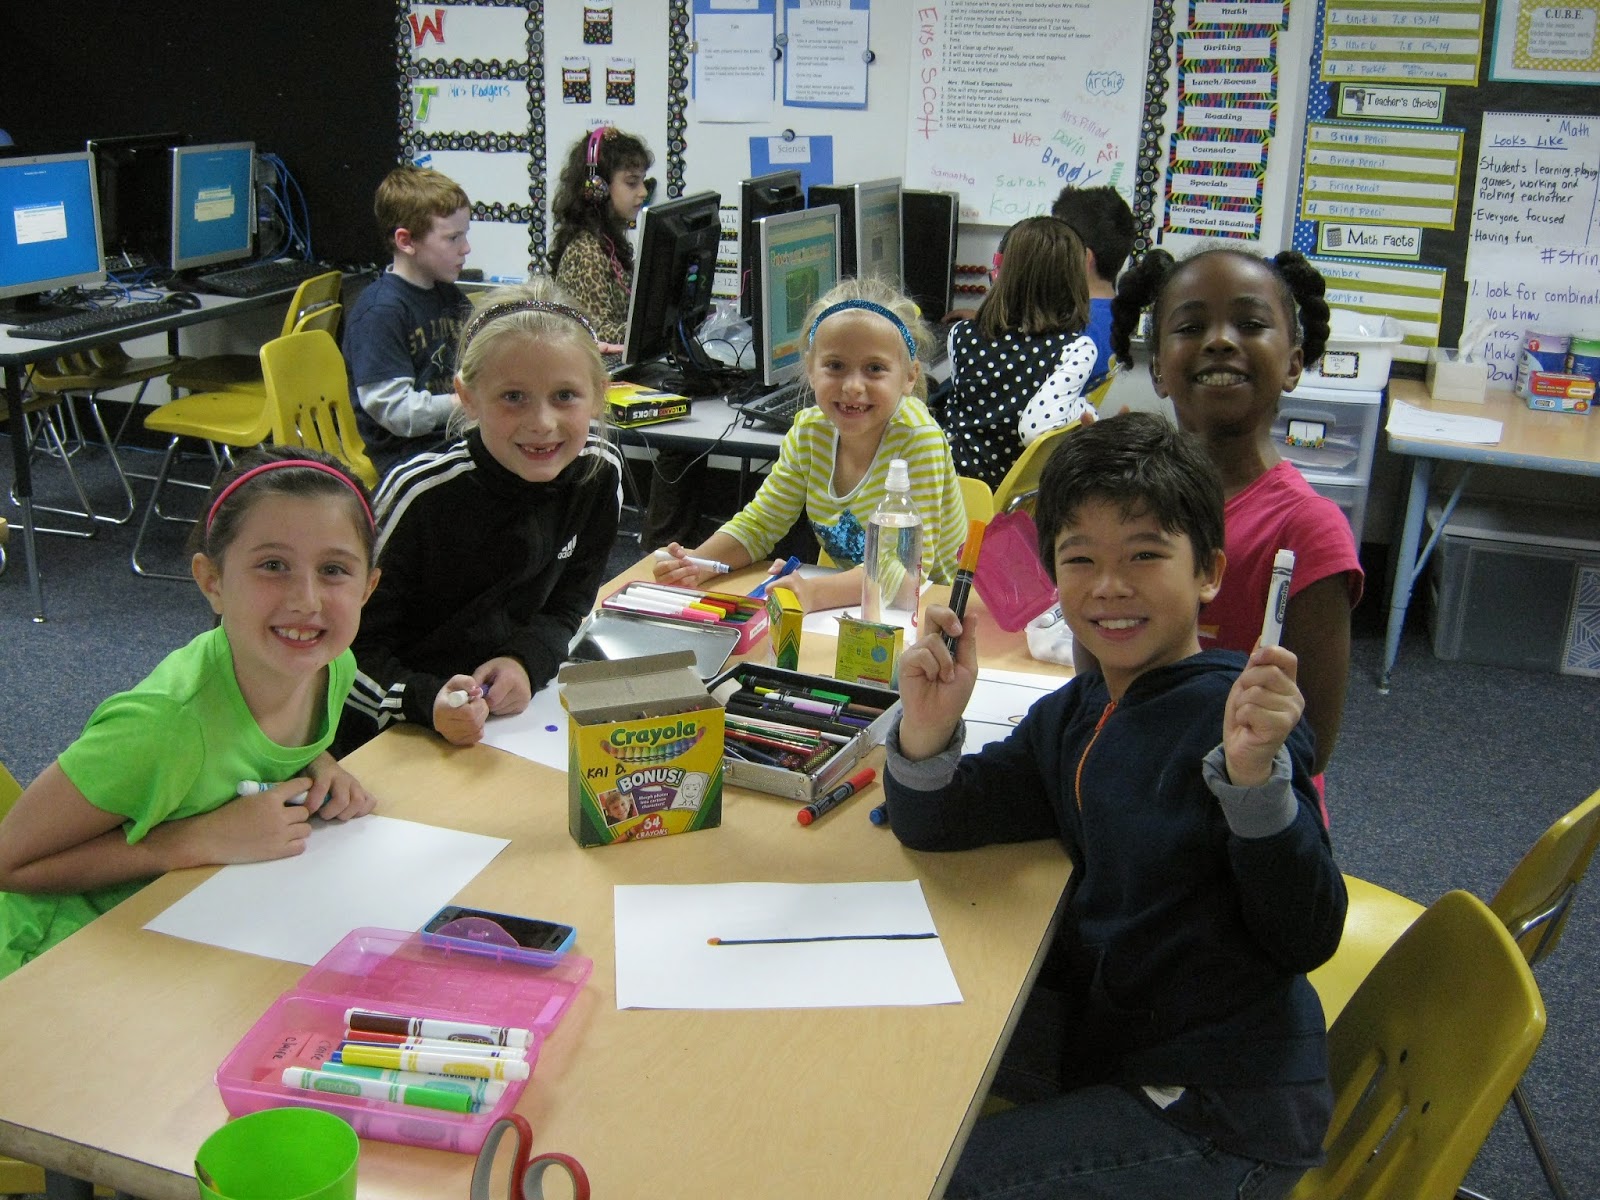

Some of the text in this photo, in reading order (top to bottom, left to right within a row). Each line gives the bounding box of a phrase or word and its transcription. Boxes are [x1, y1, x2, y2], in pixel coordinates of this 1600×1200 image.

[407, 8, 447, 48] W
[1203, 43, 1242, 52] Writing
[1366, 92, 1438, 109] Teacher's Choice
[1204, 112, 1243, 121] Reading
[1559, 120, 1590, 137] Math
[1494, 134, 1564, 146] Looks Like
[777, 144, 806, 153] Science
[1192, 145, 1237, 154] Counselor
[1480, 156, 1527, 173] Students
[996, 174, 1047, 188] Sarah
[1189, 179, 1229, 188] Specials
[1520, 178, 1556, 193] working
[1561, 178, 1579, 189] and
[1480, 188, 1515, 203] helping
[1171, 205, 1206, 215] Science
[1477, 208, 1565, 225] Everyone focused
[1189, 217, 1255, 229] Social Studies
[1347, 227, 1415, 248] Math Facts
[1474, 229, 1534, 245] Having fun
[1486, 281, 1512, 298] look
[1516, 282, 1537, 301] for
[1512, 303, 1541, 321] know
[1488, 329, 1520, 340] ross
[1483, 342, 1516, 361] Make
[611, 721, 696, 746] Crayola
[587, 766, 609, 780] KAI
[618, 768, 684, 793] BONUS!
[643, 815, 661, 830] 64
[635, 828, 669, 840] CRAYONS
